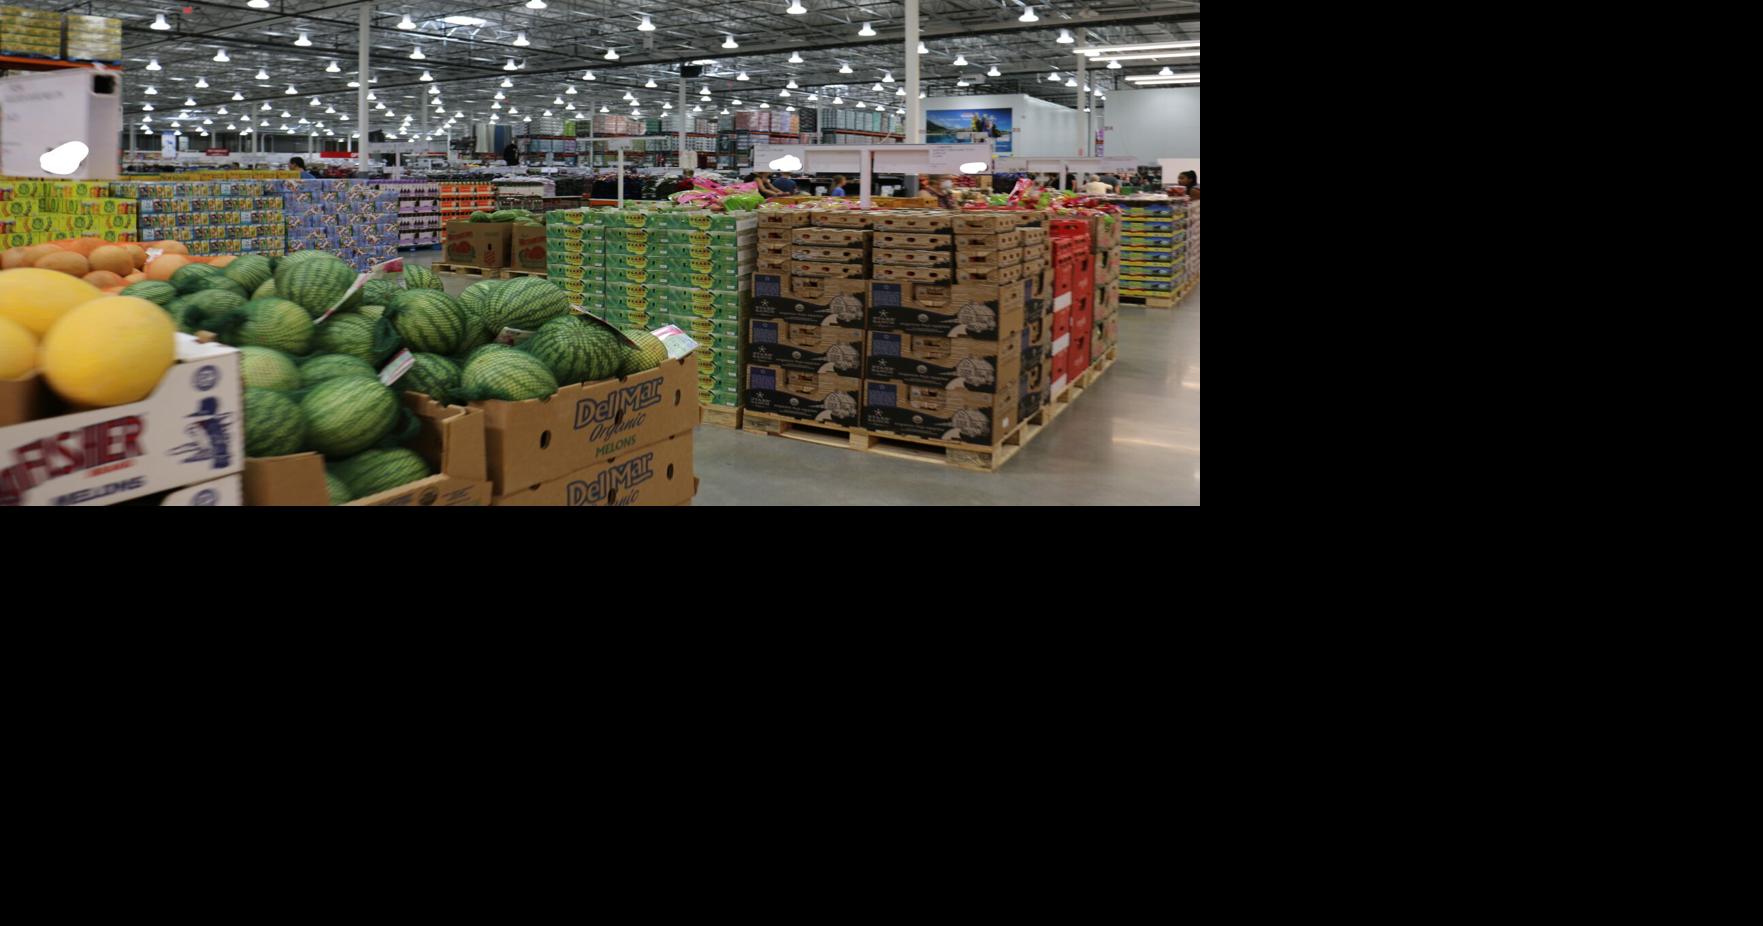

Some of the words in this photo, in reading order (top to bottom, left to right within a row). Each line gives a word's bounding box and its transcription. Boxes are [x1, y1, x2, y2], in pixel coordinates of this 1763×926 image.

[574, 390, 618, 431] Del
[619, 376, 664, 414] Mar
[590, 414, 645, 441] Organic
[595, 435, 637, 457] MELONS
[567, 471, 608, 506] Del
[608, 452, 654, 490] Mar
